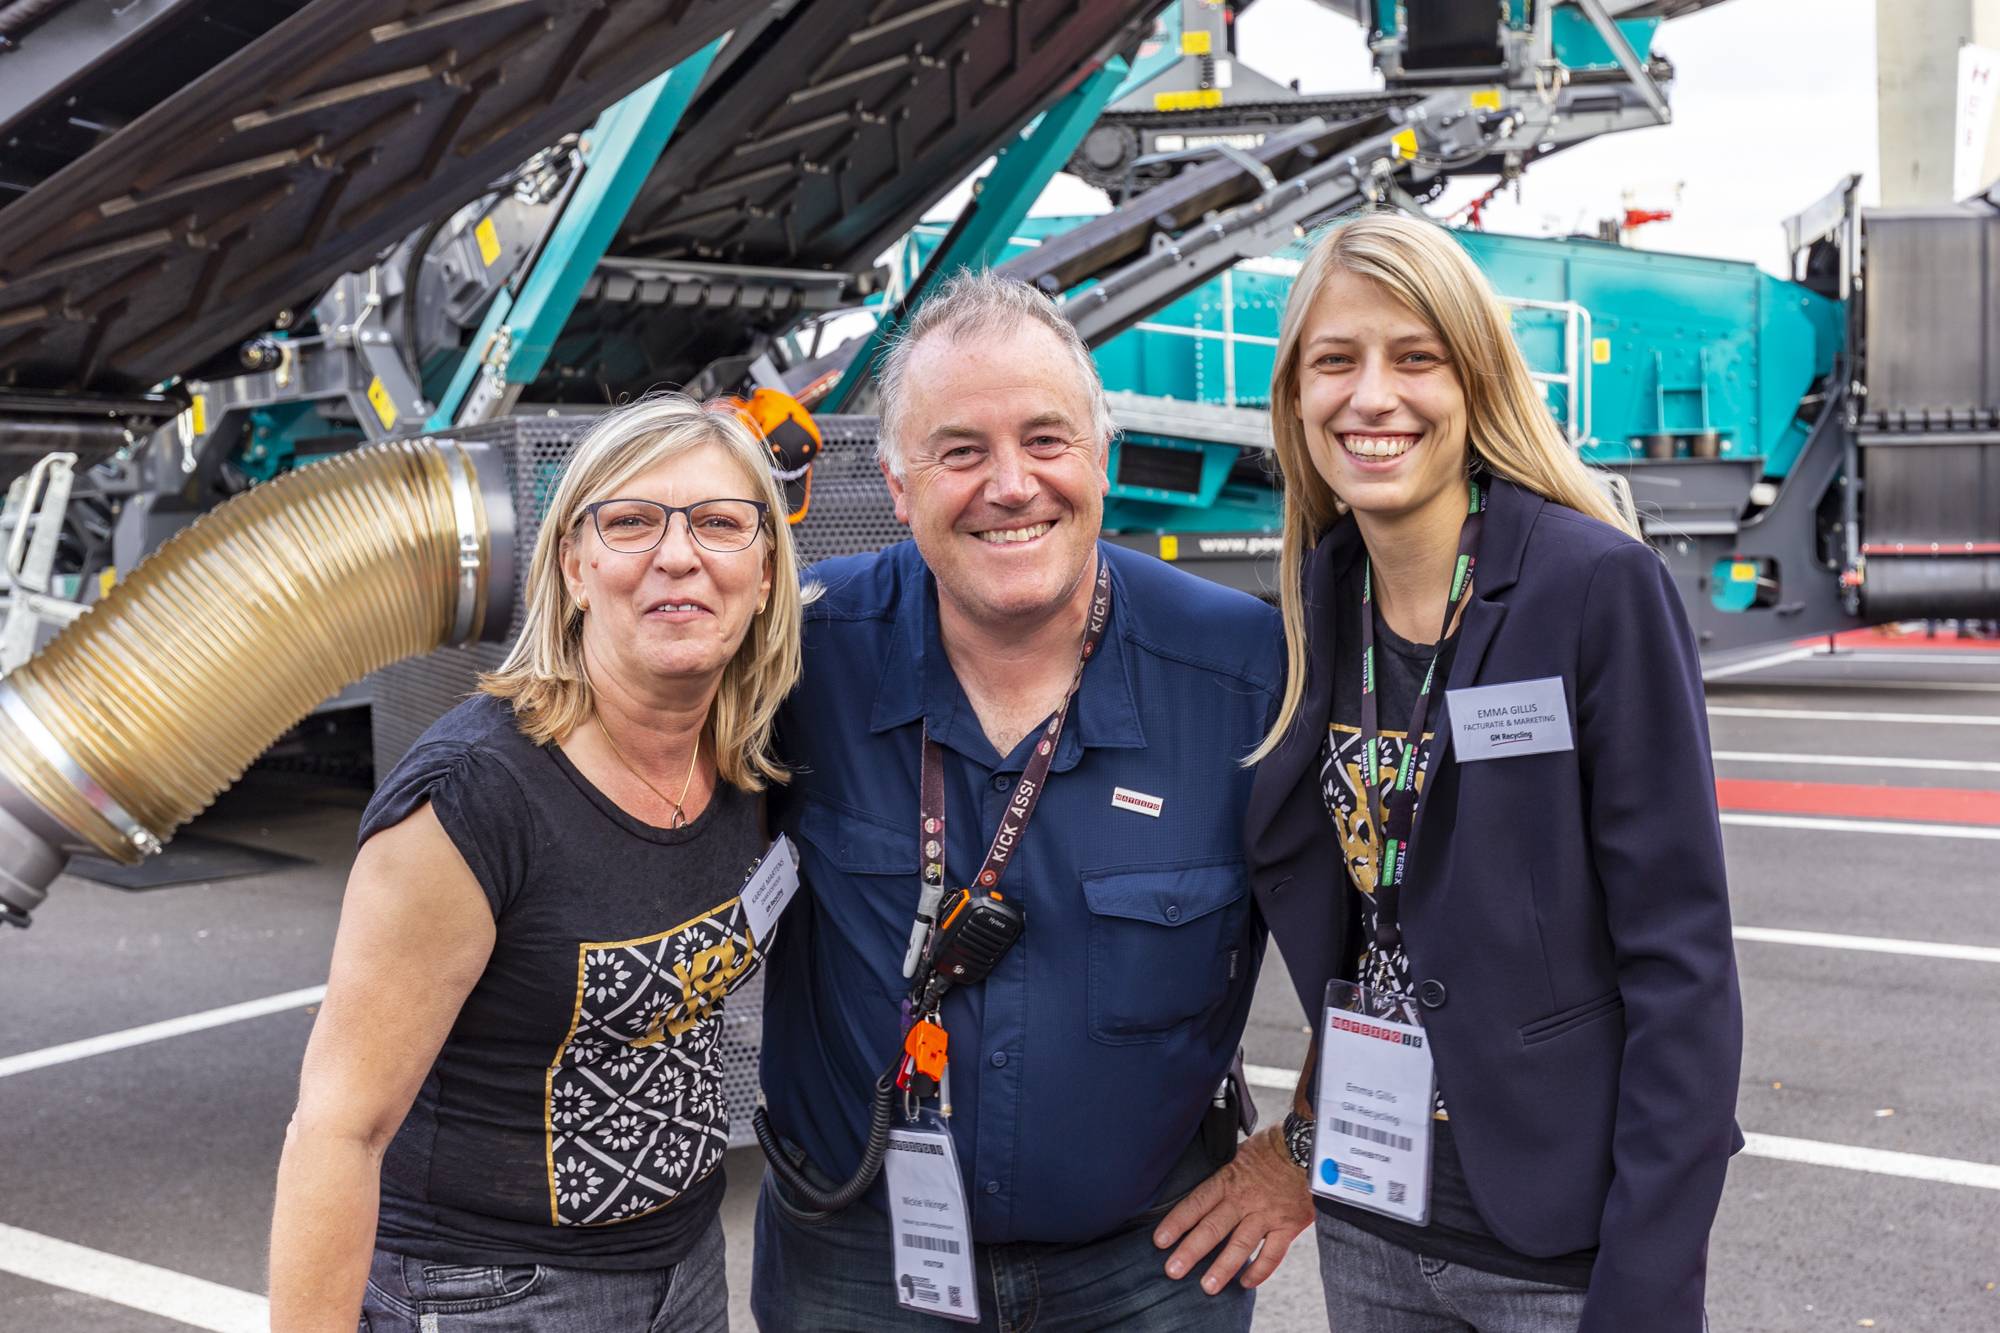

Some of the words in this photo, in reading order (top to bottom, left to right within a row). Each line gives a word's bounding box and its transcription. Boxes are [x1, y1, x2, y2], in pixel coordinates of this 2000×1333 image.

[1091, 595, 1107, 633] KICK
[1463, 720, 1505, 731] FACTURATIE
[1513, 714, 1556, 727] MARKETING
[1477, 707, 1508, 719] EMMA
[1510, 703, 1538, 715] GILLIS
[1501, 731, 1533, 741] Recycling
[1405, 755, 1417, 791] TEREX
[1115, 793, 1160, 811] MATEXPO
[992, 823, 1018, 863] KICK
[1012, 780, 1037, 818] ASS!
[1384, 848, 1394, 883] ECOTEC
[1393, 849, 1406, 885] TEREX
